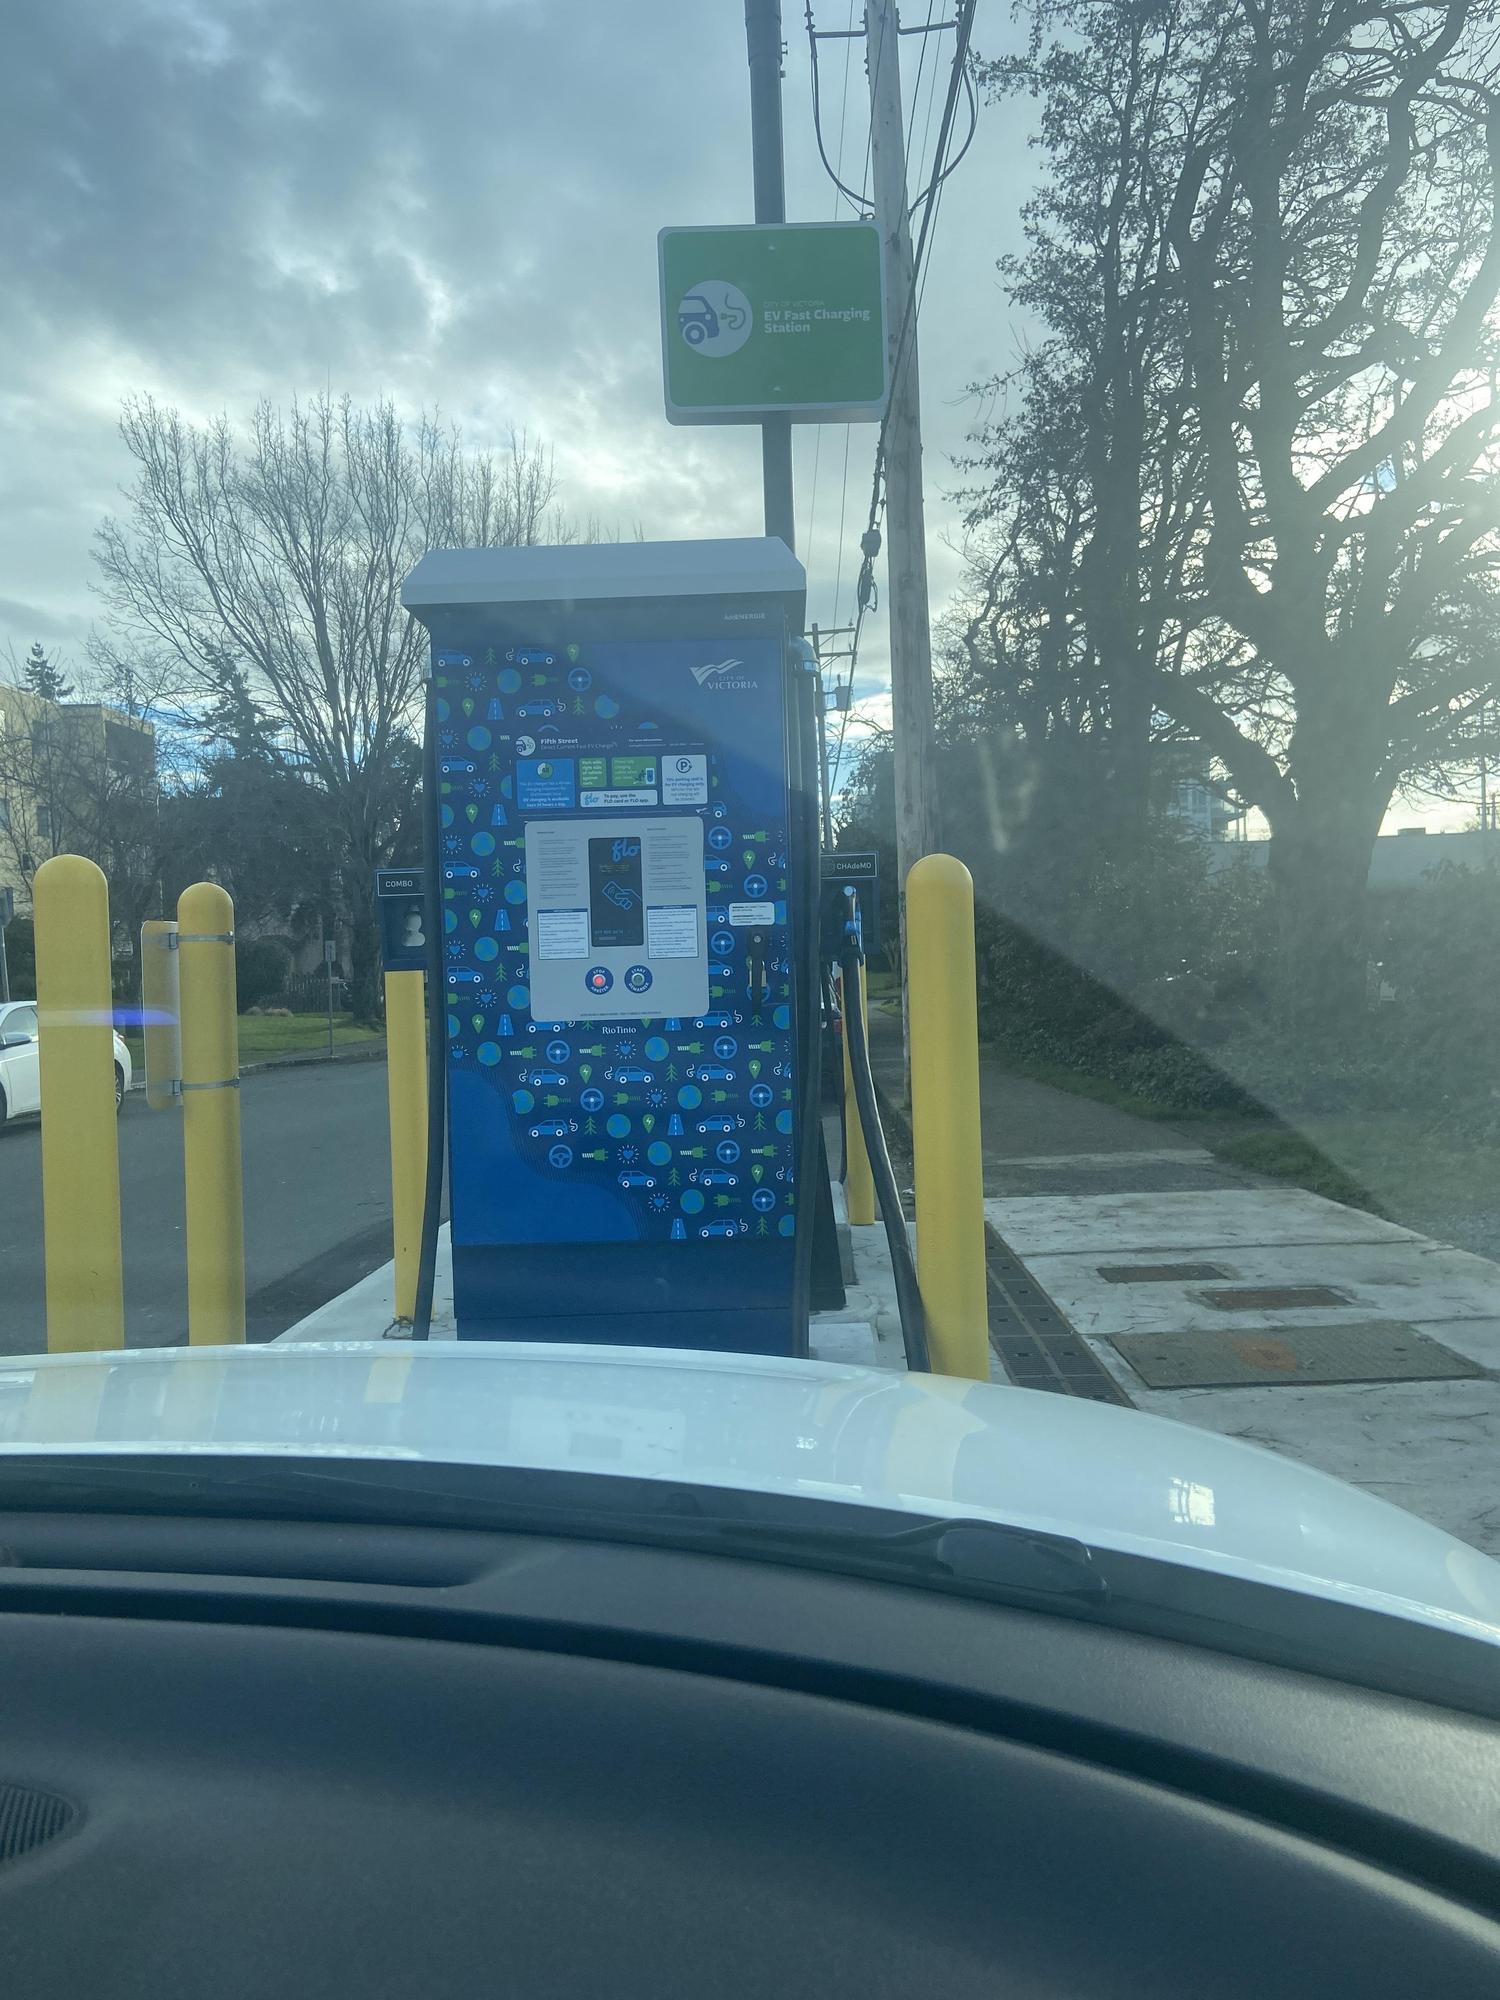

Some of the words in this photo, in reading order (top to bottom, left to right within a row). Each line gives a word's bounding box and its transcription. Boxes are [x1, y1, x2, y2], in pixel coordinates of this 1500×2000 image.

[764, 311, 780, 321] EV
[785, 309, 811, 321] Fast
[814, 307, 870, 322] Charging
[764, 322, 810, 334] Station
[707, 680, 758, 690] VICTORIA
[680, 761, 688, 771] P
[583, 793, 599, 806] flo
[611, 839, 641, 862] flo
[386, 880, 413, 888] COMBO
